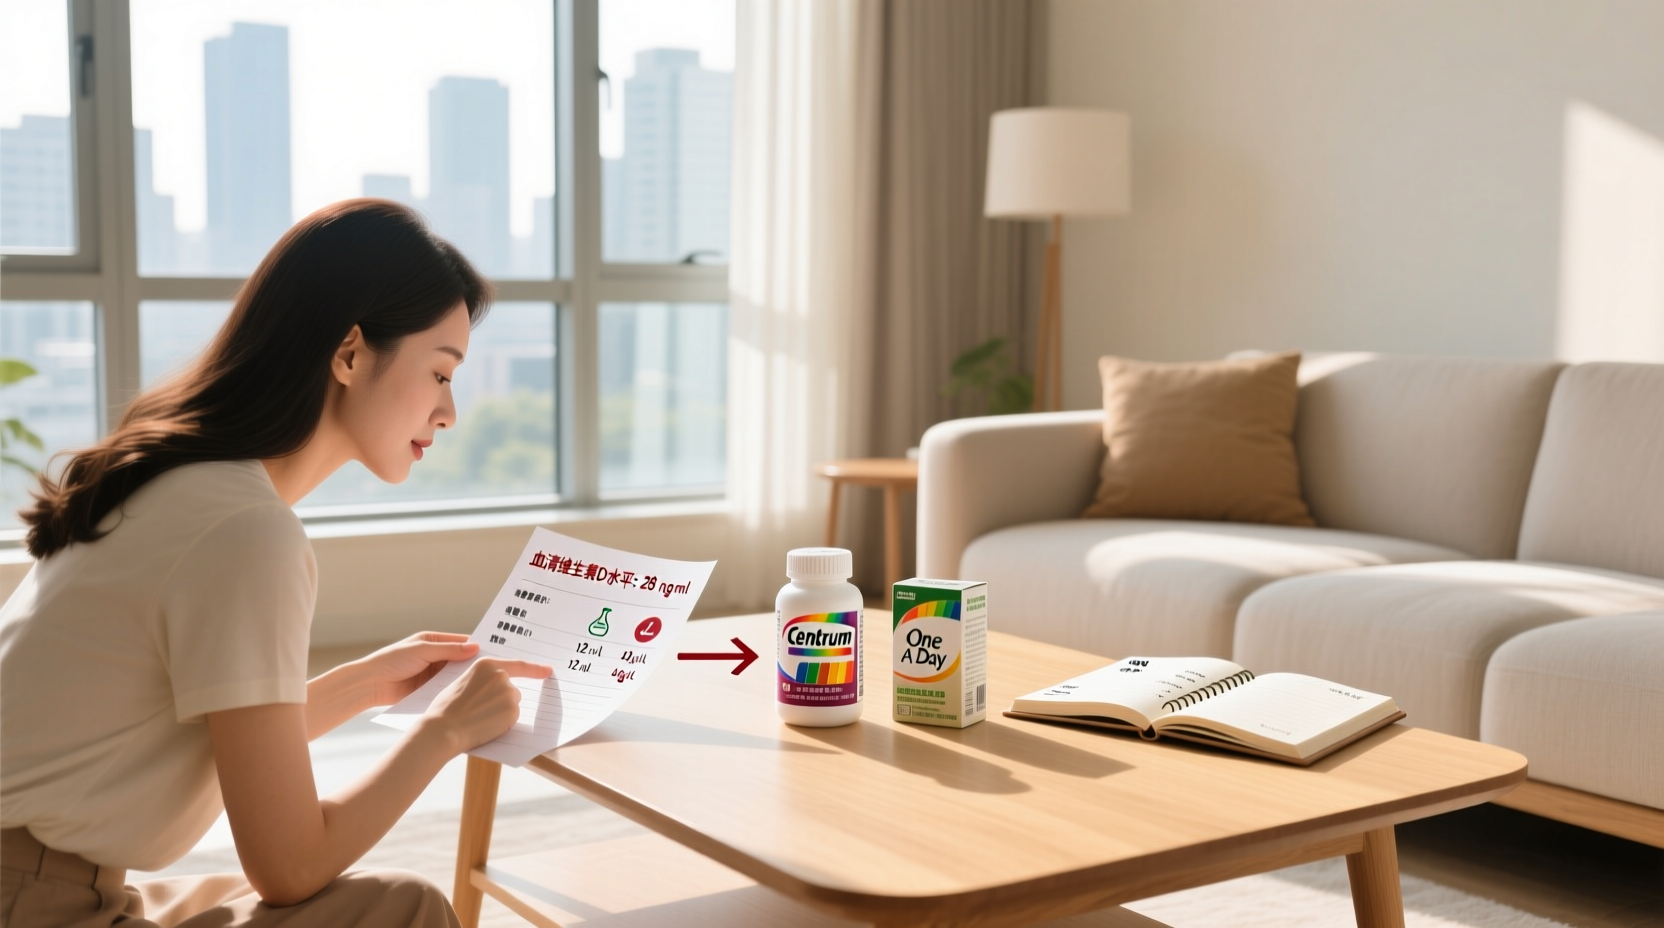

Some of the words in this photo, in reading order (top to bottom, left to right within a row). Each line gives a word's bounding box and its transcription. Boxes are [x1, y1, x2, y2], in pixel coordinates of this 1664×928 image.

[788, 626, 852, 646] Centrum
[906, 628, 943, 649] One
[900, 648, 913, 664] A
[915, 647, 947, 671] Day
